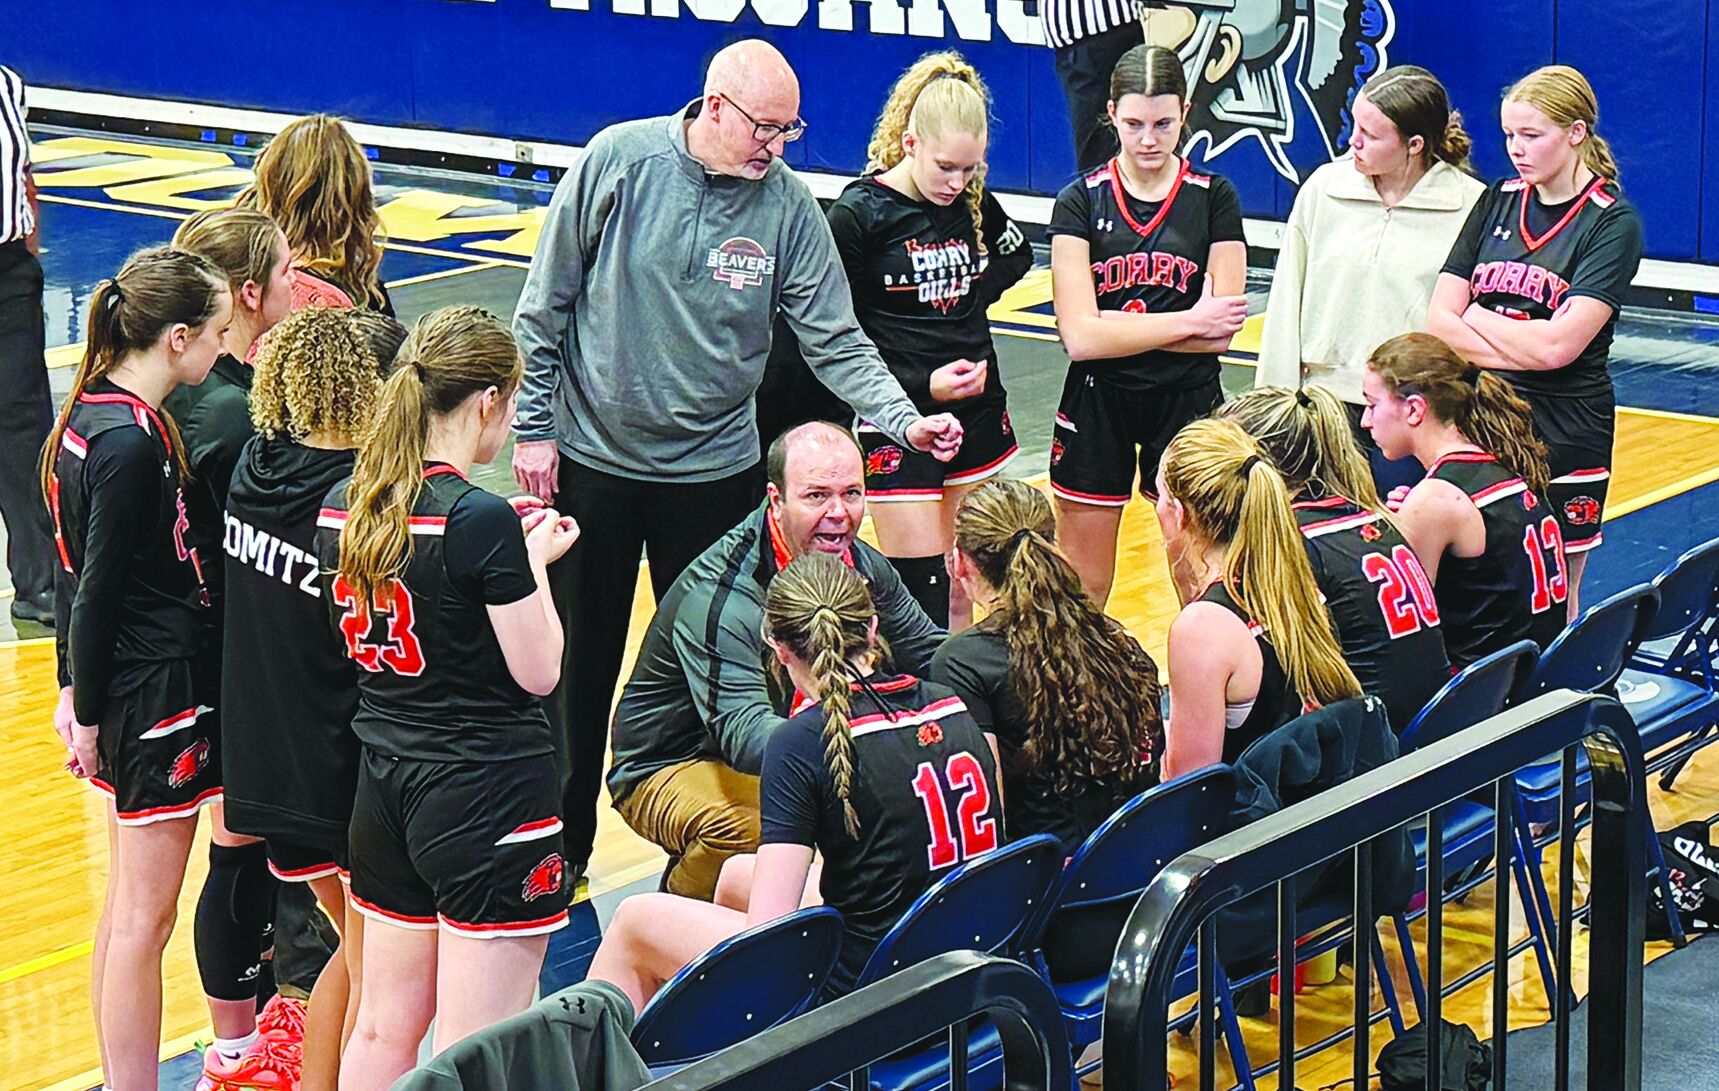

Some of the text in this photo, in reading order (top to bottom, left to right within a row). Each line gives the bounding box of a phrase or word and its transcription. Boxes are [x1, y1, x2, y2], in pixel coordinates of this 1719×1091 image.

[706, 249, 775, 273] BEAVERS
[996, 219, 1024, 255] 20
[1471, 261, 1569, 310] CORRY
[223, 510, 321, 597] OMITZ
[1362, 544, 1441, 640] 20
[1523, 515, 1568, 614] 13
[332, 573, 425, 677] 23
[911, 751, 998, 871] 12
